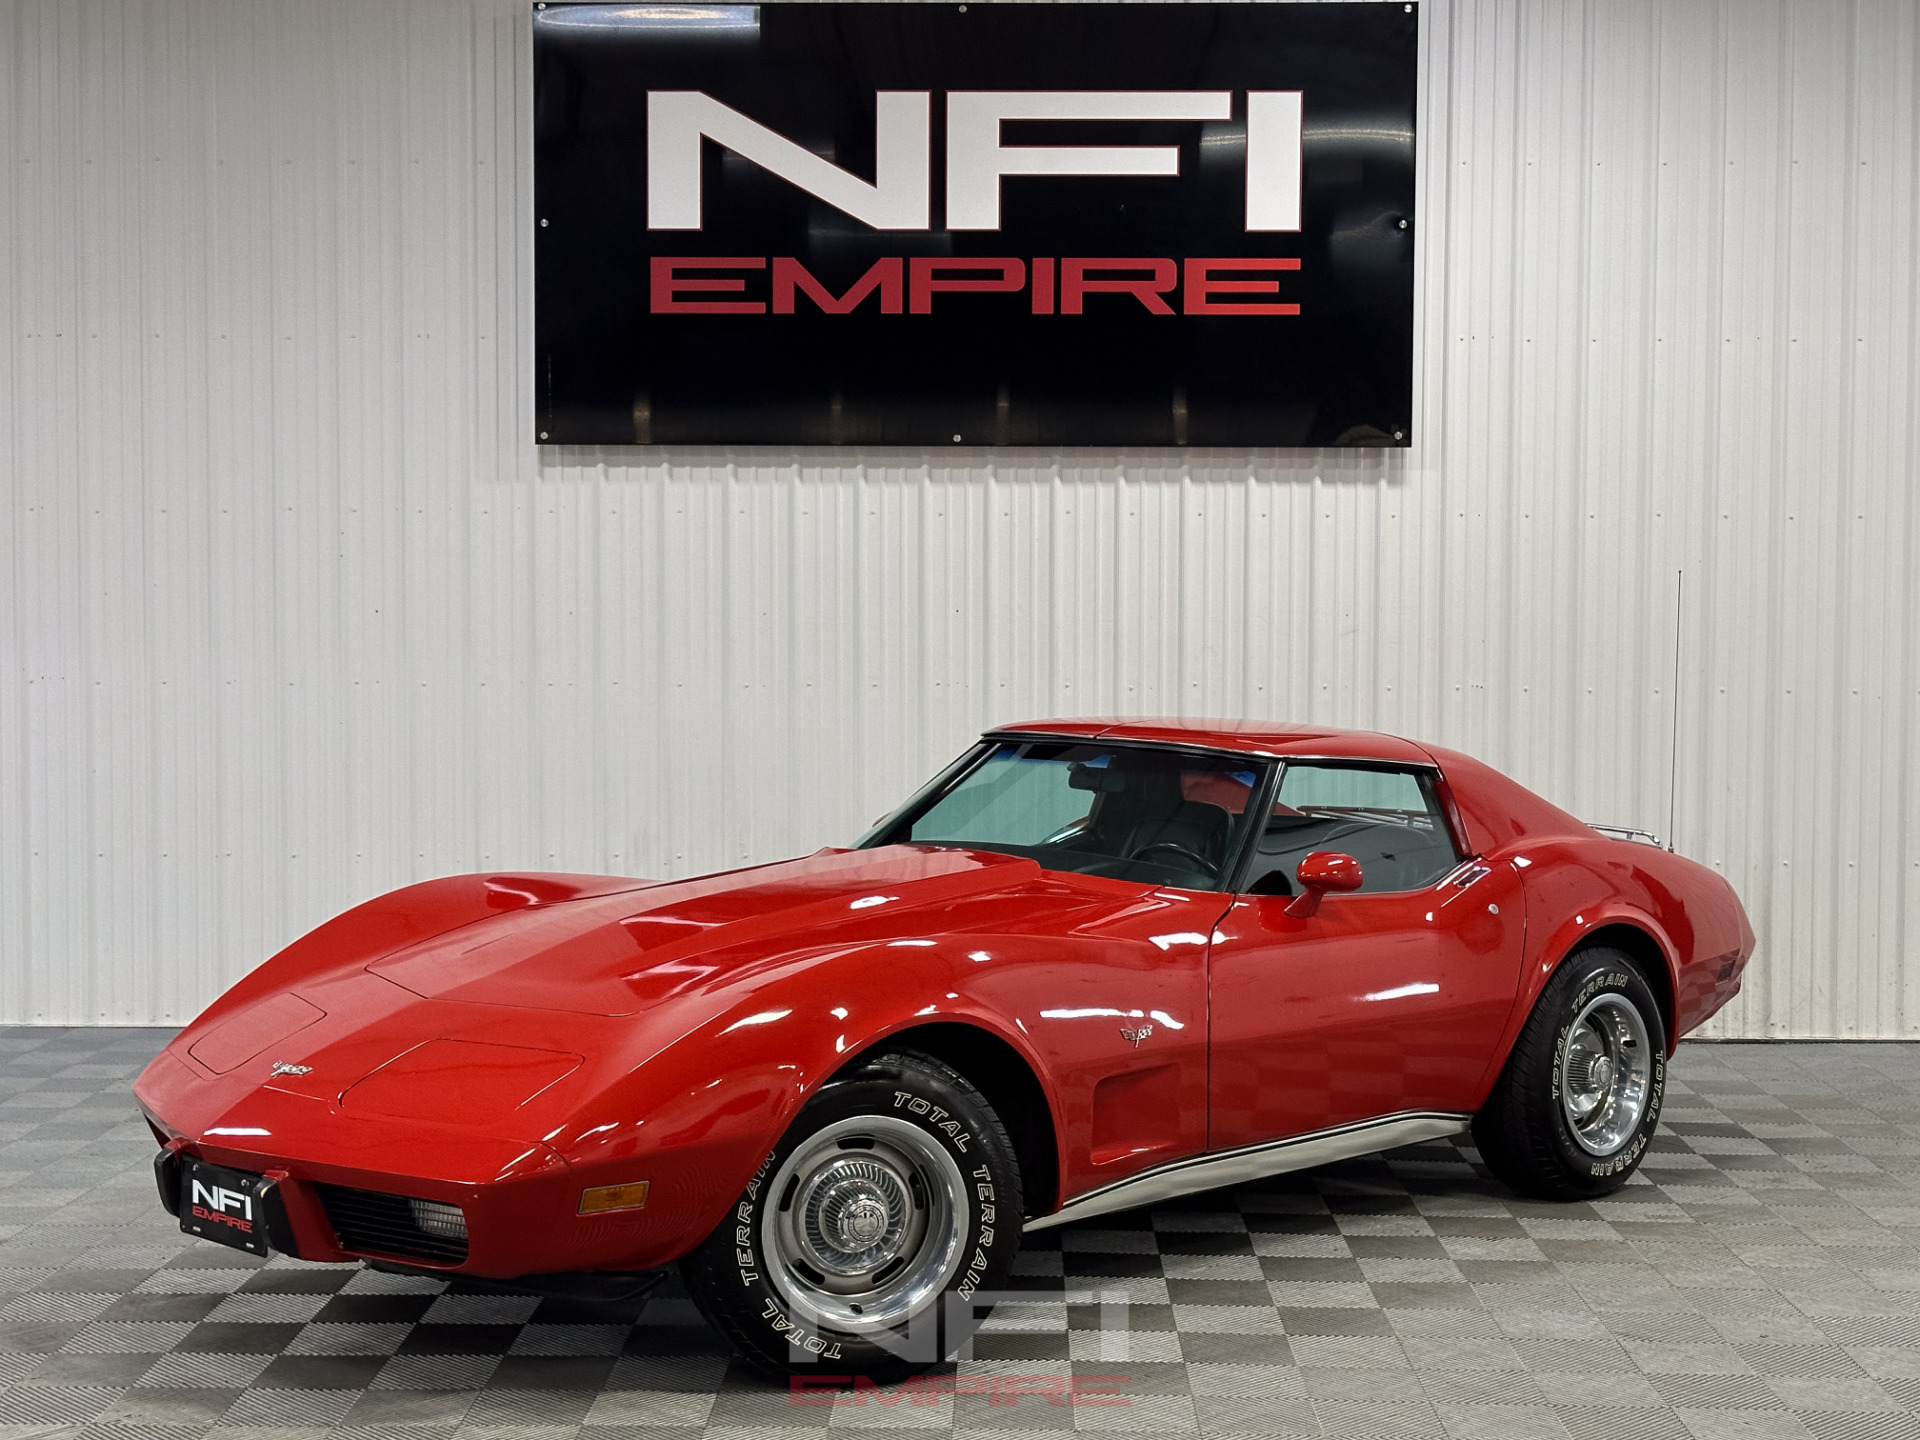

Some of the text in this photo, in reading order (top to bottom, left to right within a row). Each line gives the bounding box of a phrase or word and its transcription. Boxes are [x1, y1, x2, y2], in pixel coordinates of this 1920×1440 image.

[647, 90, 1303, 231] NFI
[650, 257, 1301, 315] EMPIRE
[1552, 973, 1628, 1099] TOTAL TERRAIN
[1591, 1050, 1663, 1176] TOTAL TERRAIN
[192, 1179, 252, 1220] NFI
[192, 1205, 252, 1234] EMPIRE
[894, 1091, 995, 1301] TOTAL TERRAIN
[762, 1297, 842, 1359] TOTAL
